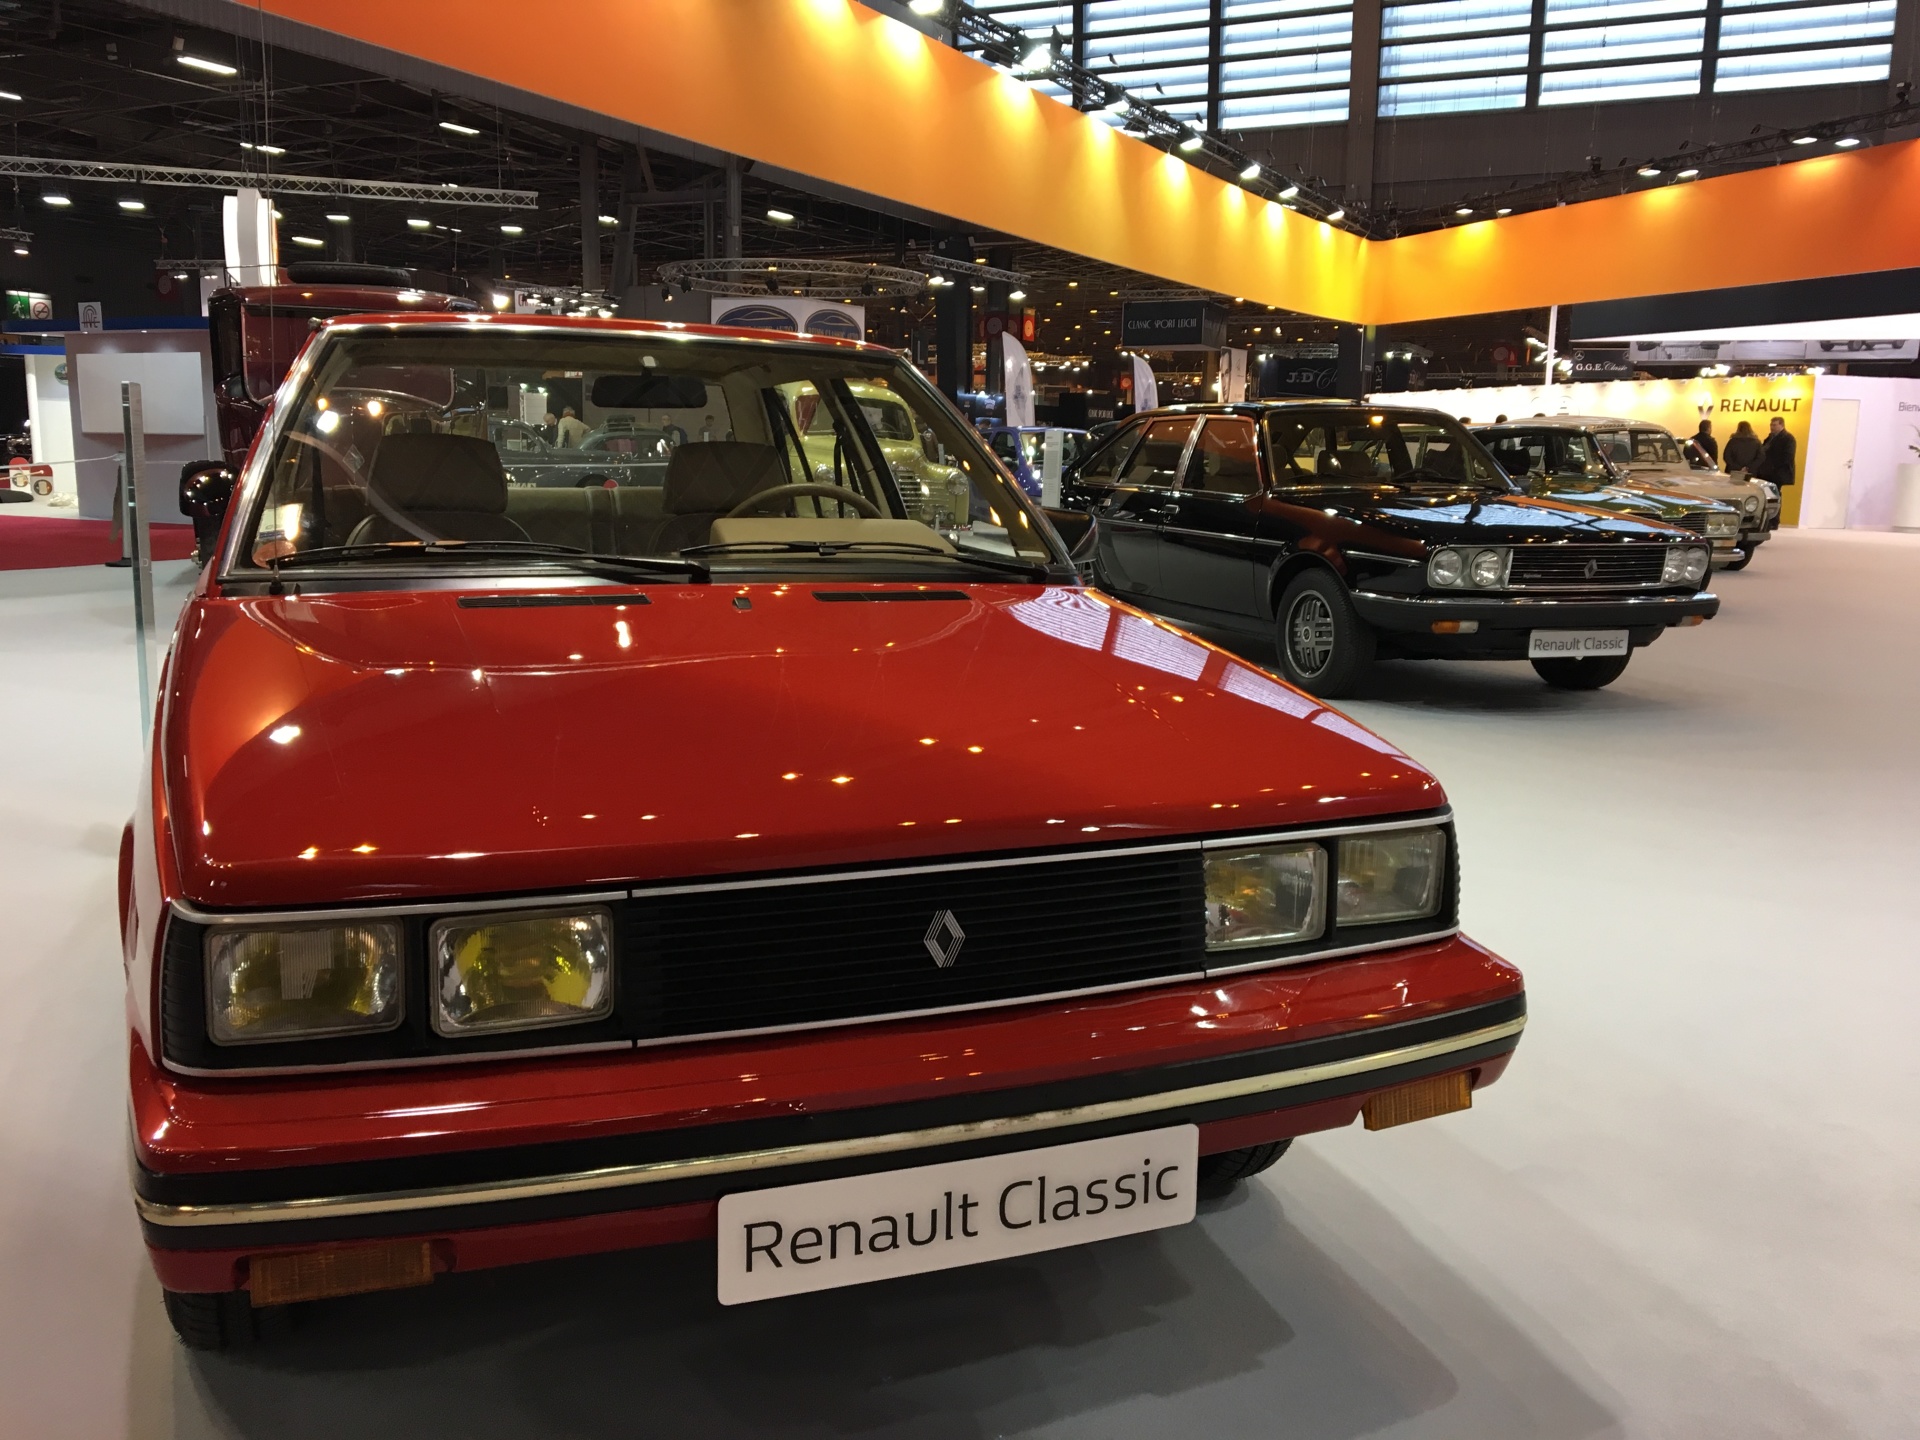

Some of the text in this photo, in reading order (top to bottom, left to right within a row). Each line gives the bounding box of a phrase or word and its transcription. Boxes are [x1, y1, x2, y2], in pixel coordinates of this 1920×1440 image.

[1128, 320, 1152, 330] CLASSIC
[1154, 319, 1175, 329] SPORT
[1720, 398, 1802, 412] RENAULT
[1533, 636, 1624, 651] Renault Classic
[743, 1158, 1179, 1273] Renault Classic
